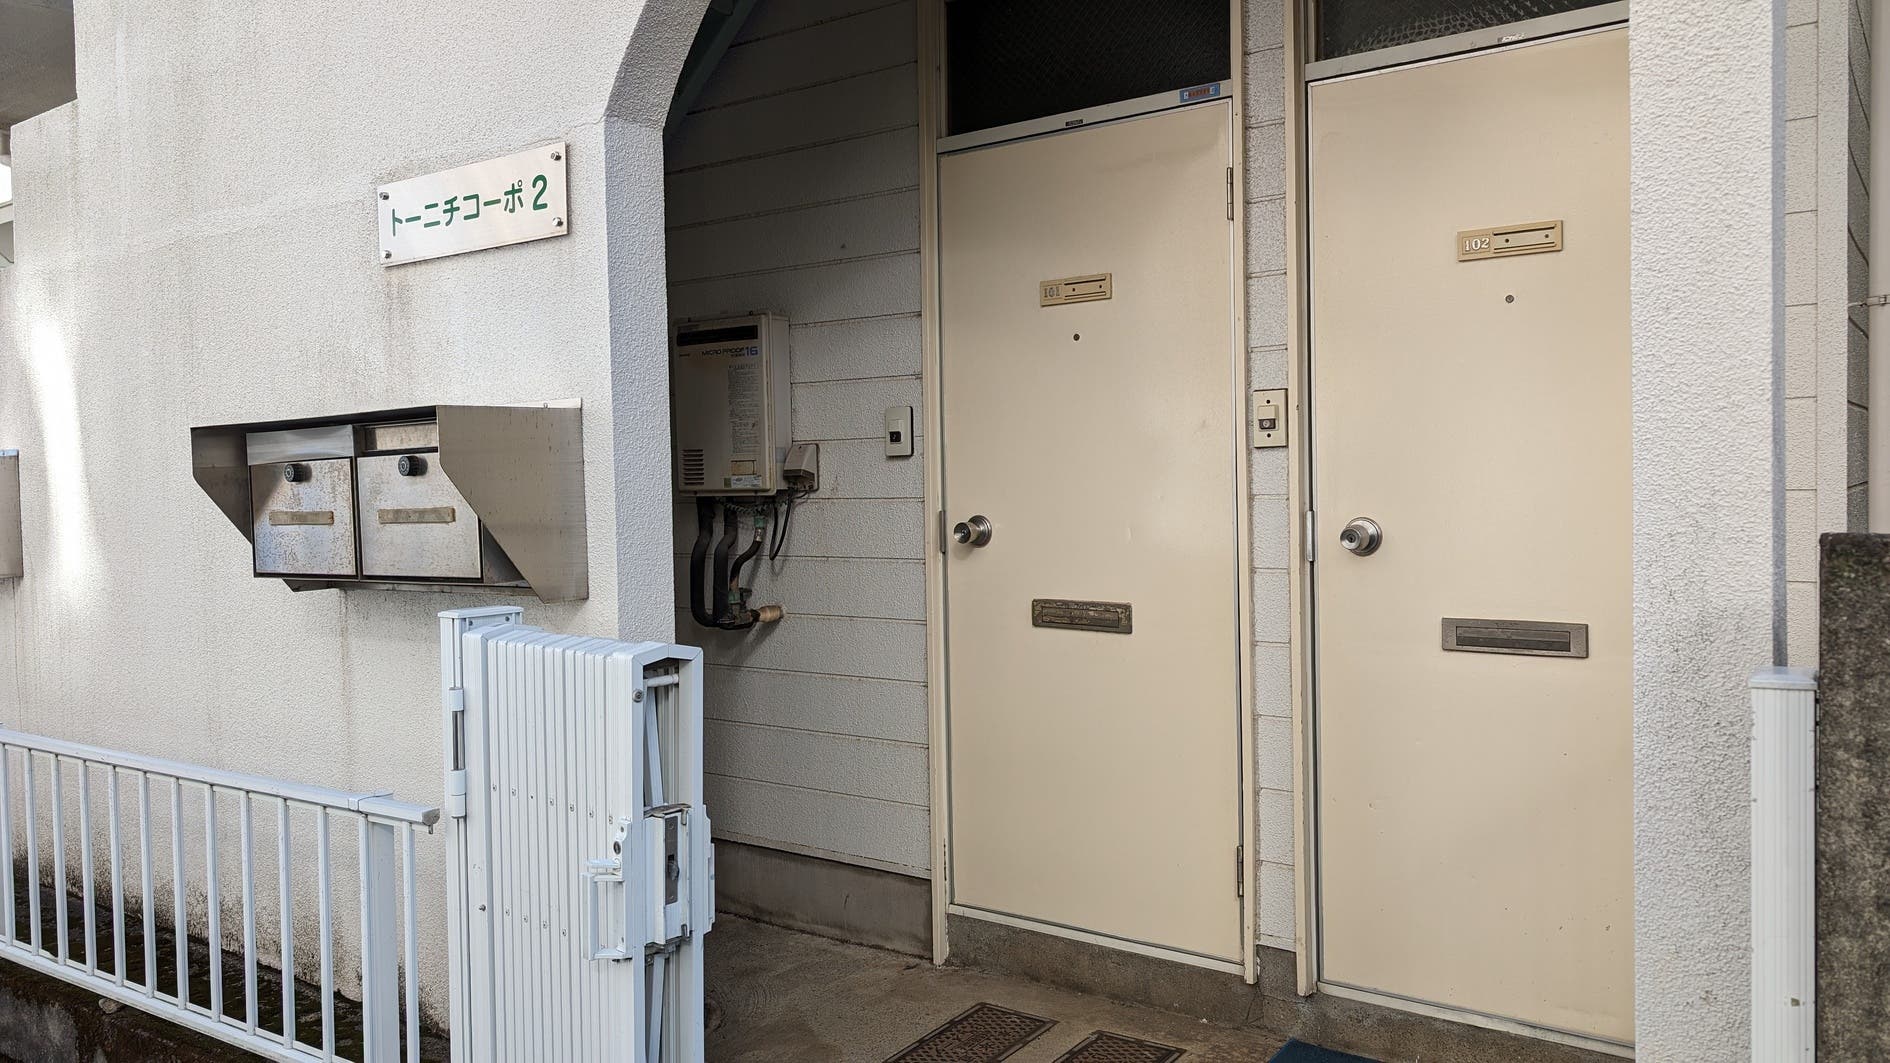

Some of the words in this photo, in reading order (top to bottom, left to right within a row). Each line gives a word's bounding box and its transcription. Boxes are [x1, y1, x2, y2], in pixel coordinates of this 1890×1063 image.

[1464, 237, 1490, 251] 102
[1043, 285, 1061, 298] 101
[745, 345, 759, 357] 16
